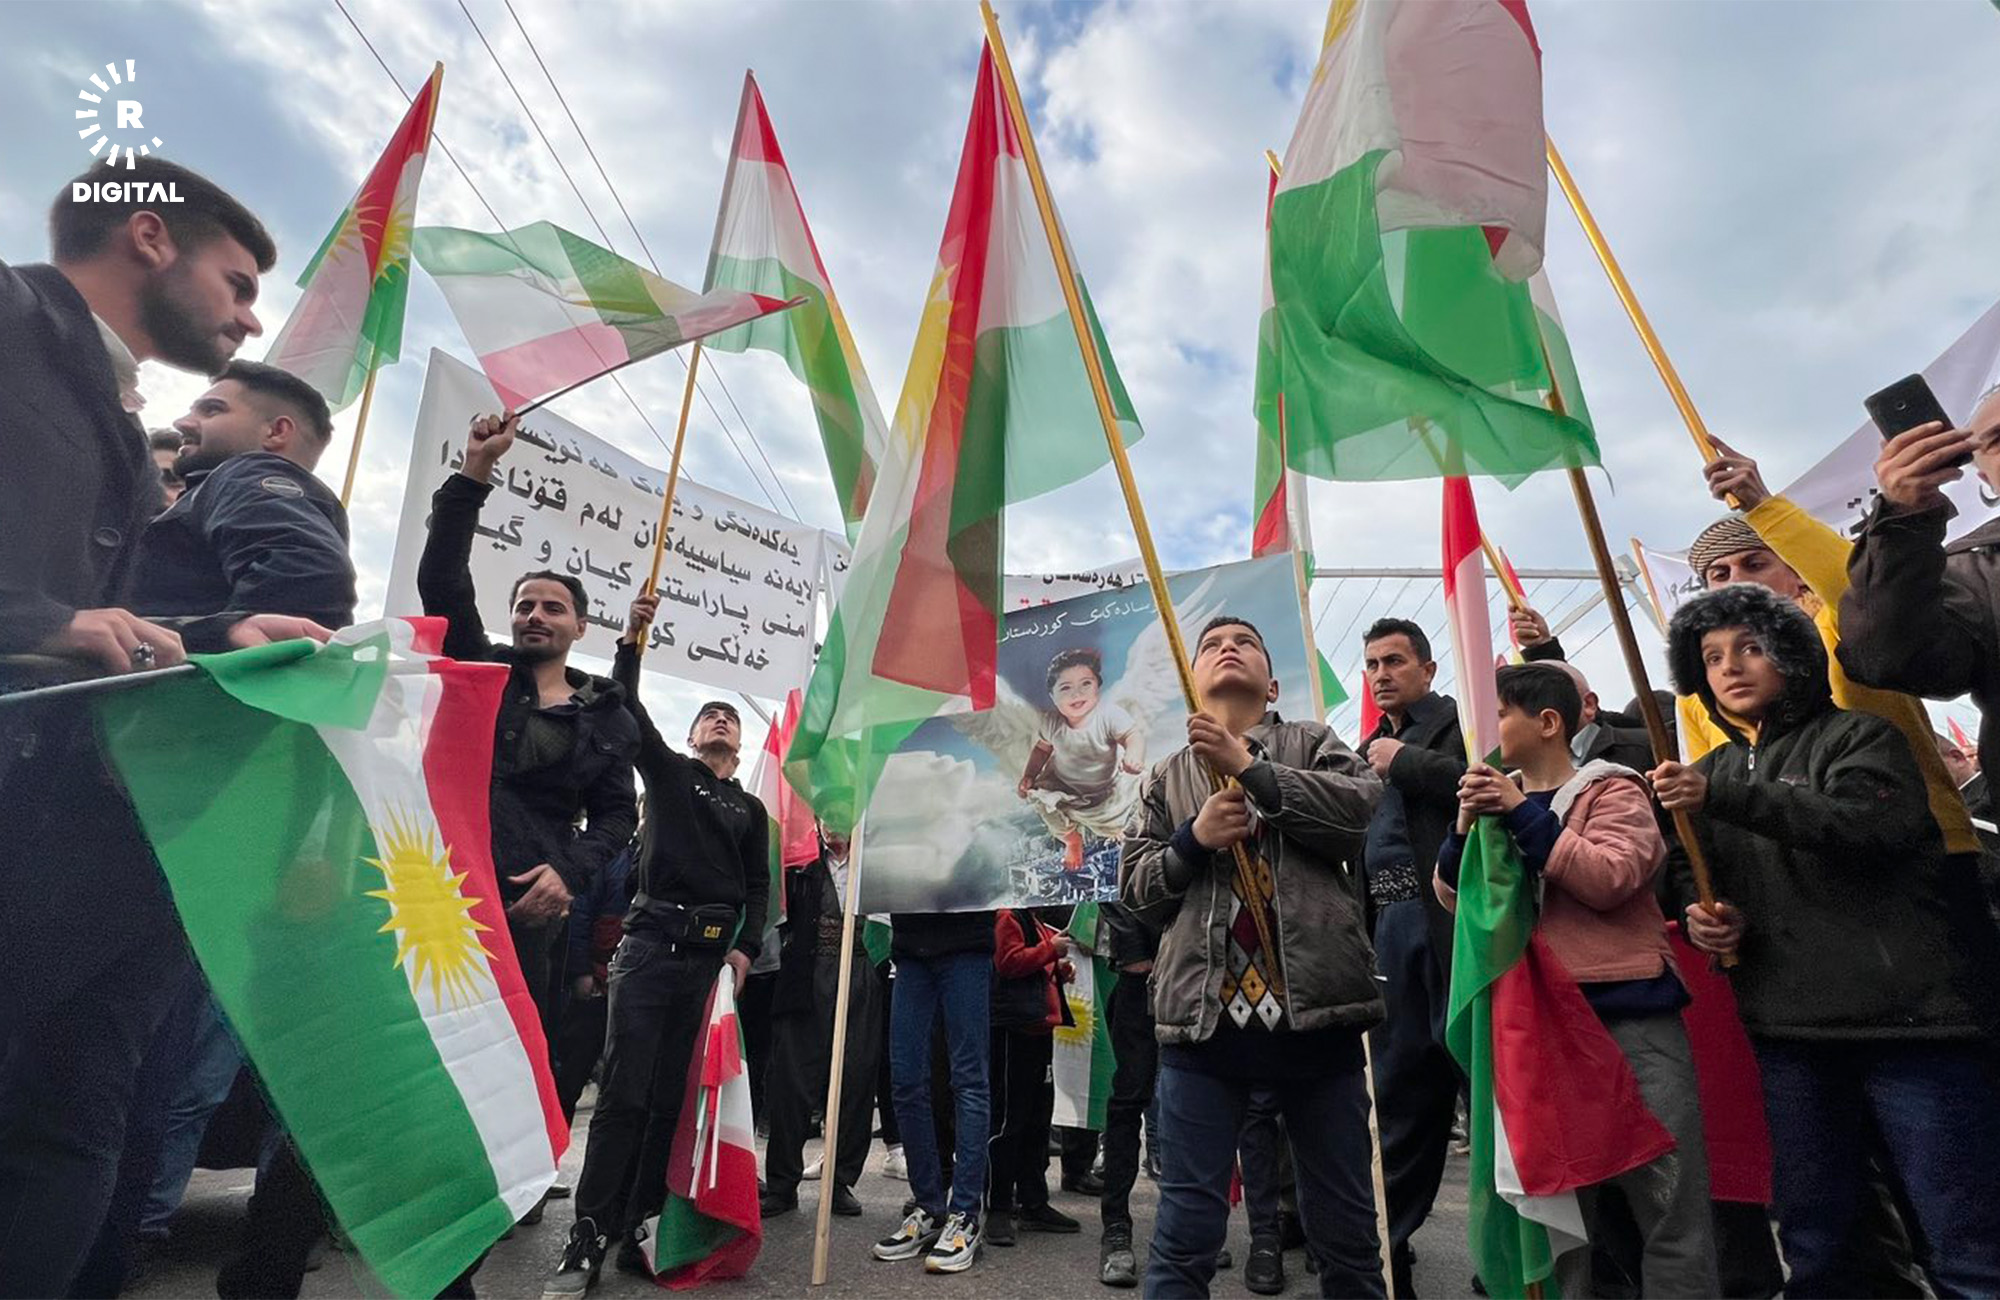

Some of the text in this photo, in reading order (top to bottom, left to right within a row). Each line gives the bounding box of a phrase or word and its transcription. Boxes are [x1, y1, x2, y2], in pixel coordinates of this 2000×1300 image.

[580, 502, 623, 531] لەم
[534, 540, 552, 564] و
[656, 576, 750, 635] پاراستن
[704, 925, 722, 939] CAT
